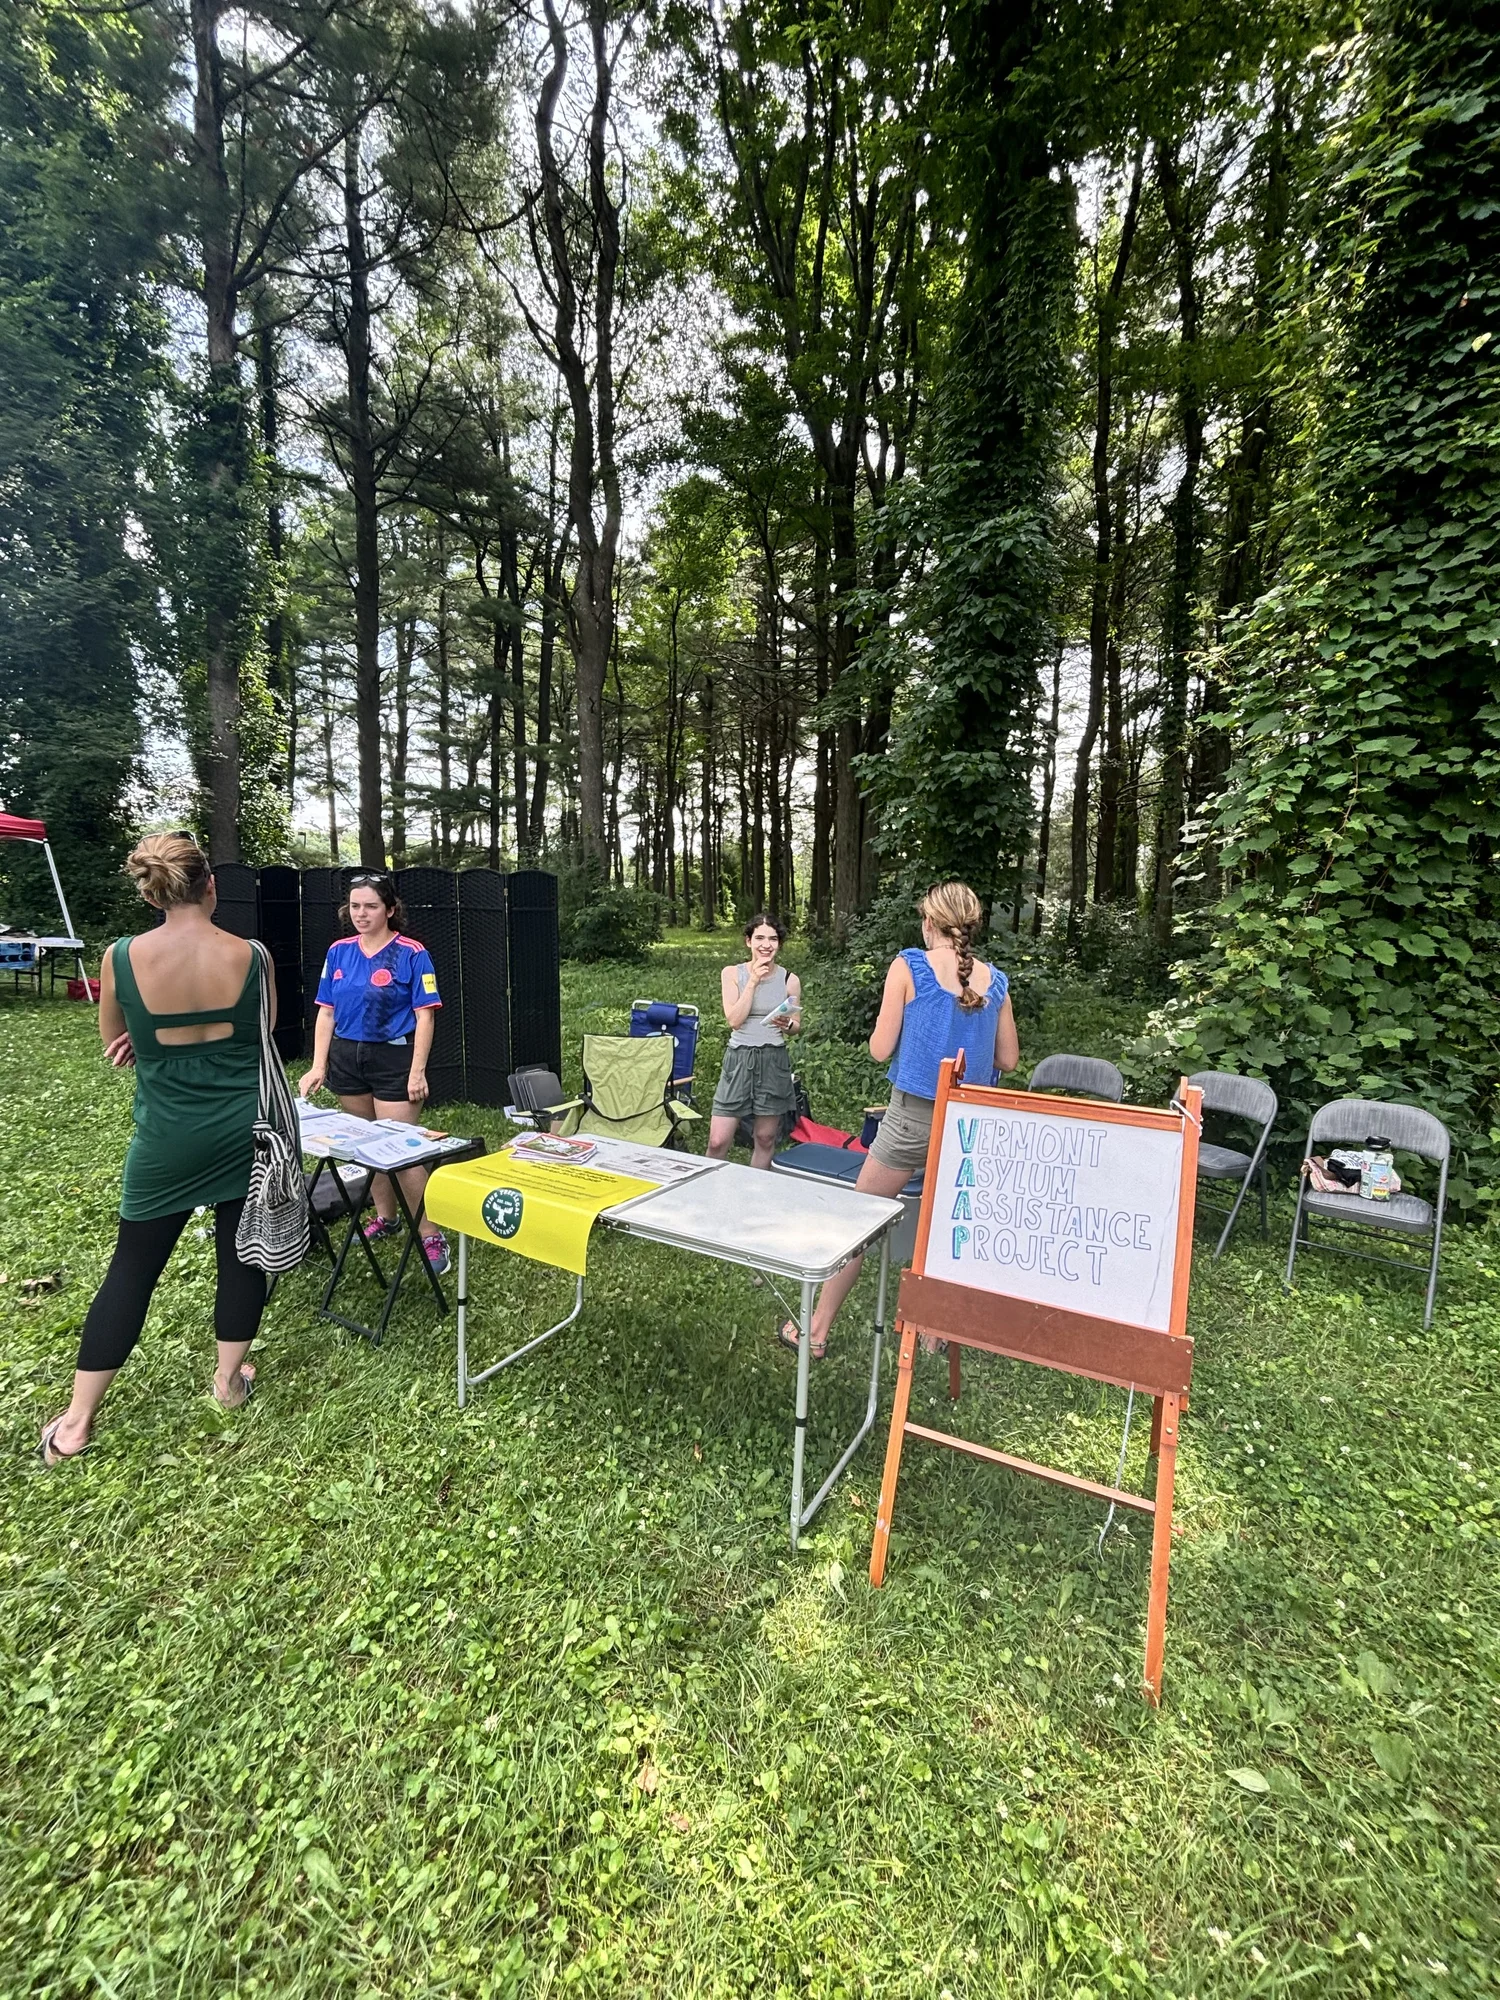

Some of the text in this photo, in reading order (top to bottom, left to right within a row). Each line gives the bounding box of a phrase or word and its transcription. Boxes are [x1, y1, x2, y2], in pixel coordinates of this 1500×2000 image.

[957, 1117, 1107, 1167] VERMONT
[485, 1192, 498, 1208] PINE
[955, 1156, 1076, 1204] ASYLUM
[485, 1215, 515, 1235] ASSISTANCE
[951, 1190, 1151, 1250] ASSISTANCE
[952, 1225, 1107, 1285] PROJECT
